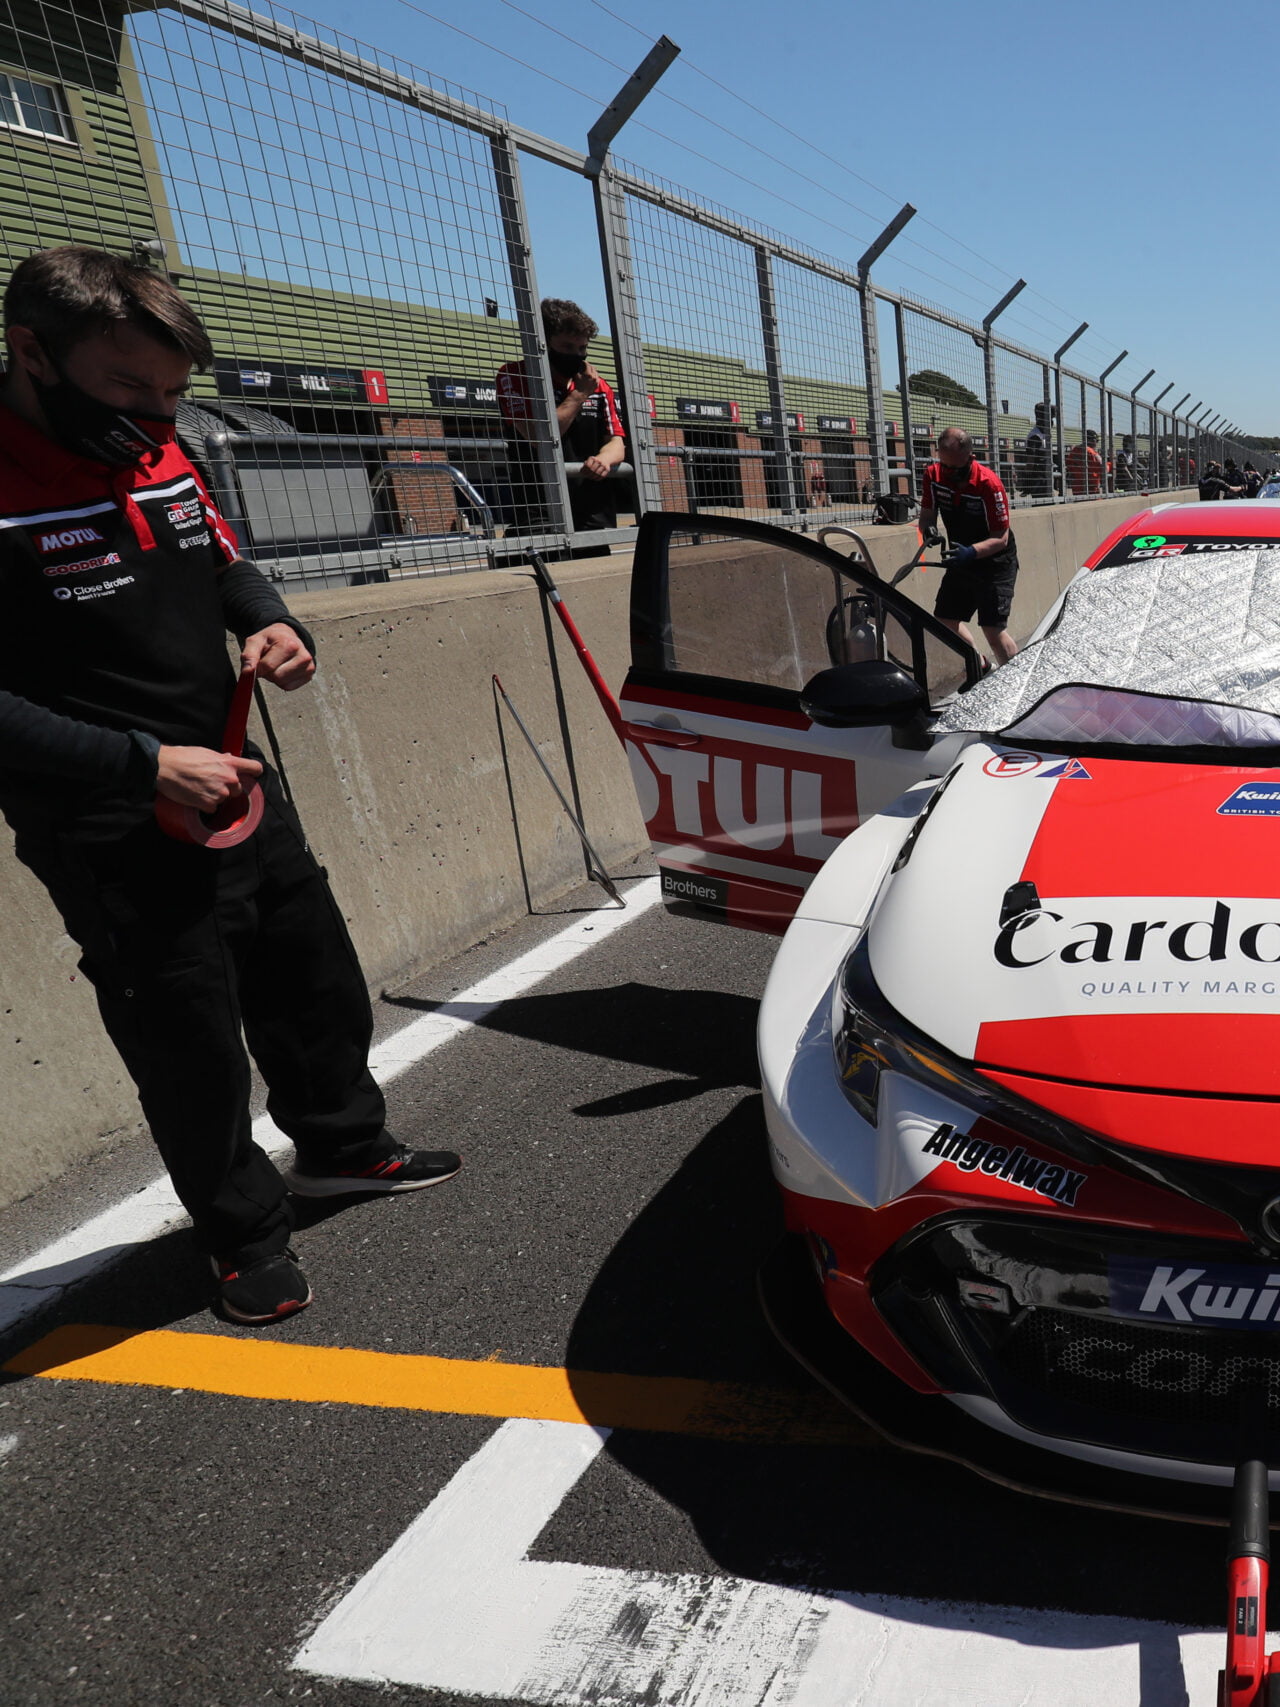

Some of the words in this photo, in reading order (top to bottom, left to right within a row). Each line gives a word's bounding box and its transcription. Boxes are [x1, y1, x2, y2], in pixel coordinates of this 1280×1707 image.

[300, 375, 330, 391] HILL
[371, 377, 380, 396] 1
[166, 509, 186, 523] GR
[41, 526, 104, 551] MOTUL
[1132, 547, 1182, 559] GR
[44, 552, 121, 577] GOODRIDGE
[73, 584, 103, 597] Close
[103, 575, 135, 591] Brothers
[664, 876, 717, 900] Brothers
[1081, 979, 1190, 998] QUALITY
[922, 1123, 1088, 1208] Angelwax
